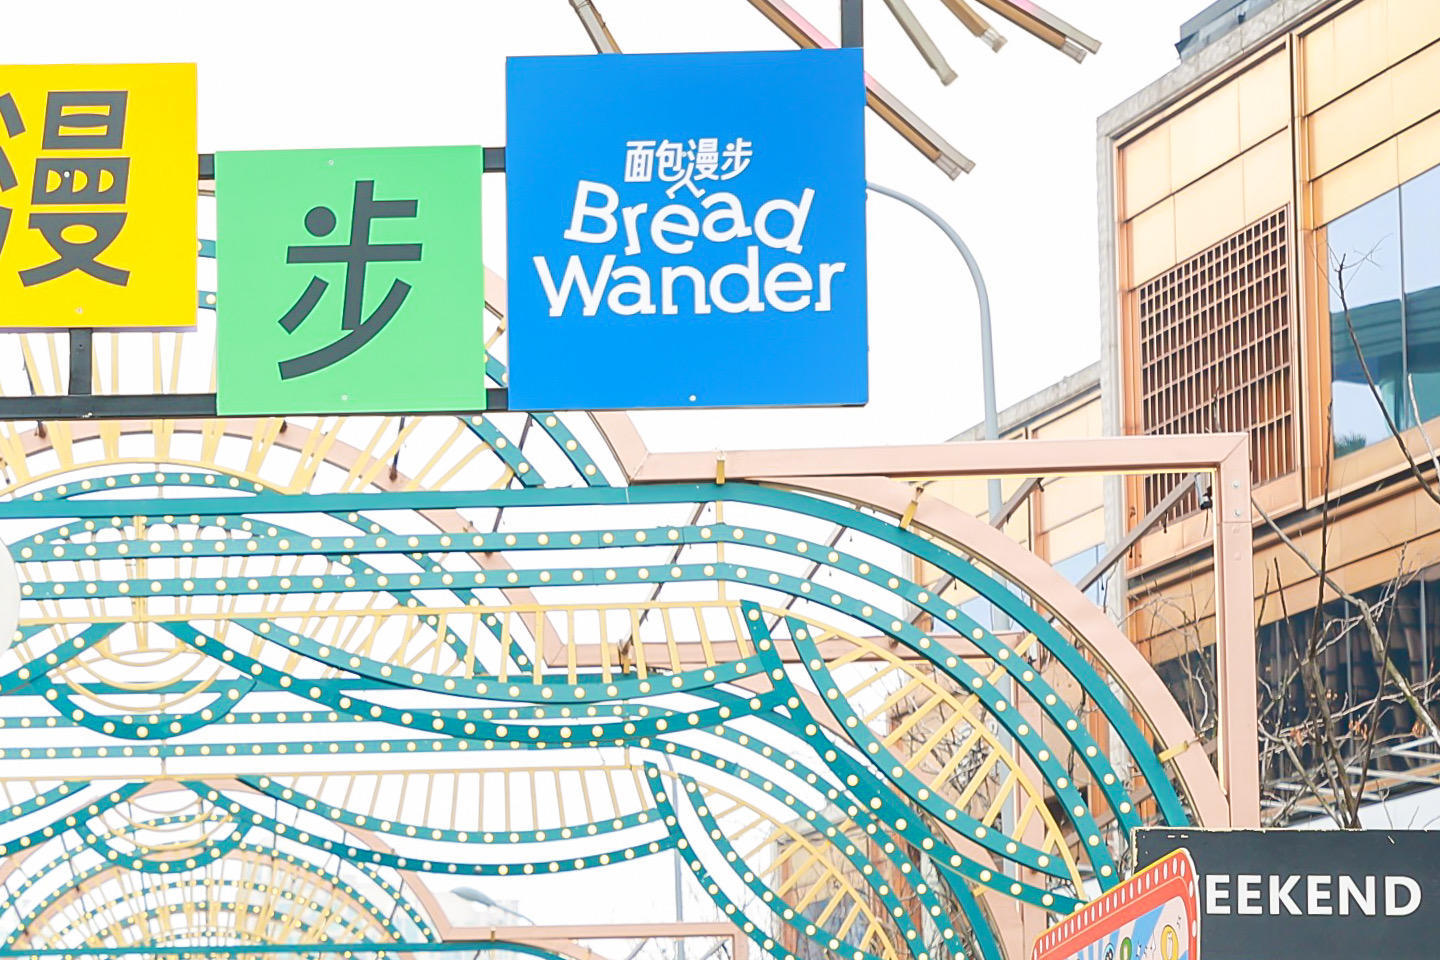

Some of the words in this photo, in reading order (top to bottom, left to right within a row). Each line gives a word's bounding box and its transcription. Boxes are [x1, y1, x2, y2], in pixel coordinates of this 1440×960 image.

[623, 137, 754, 186] 面包漫步
[563, 178, 816, 256] Bread
[532, 244, 847, 318] Wander
[1197, 873, 1423, 917] EEKEND
